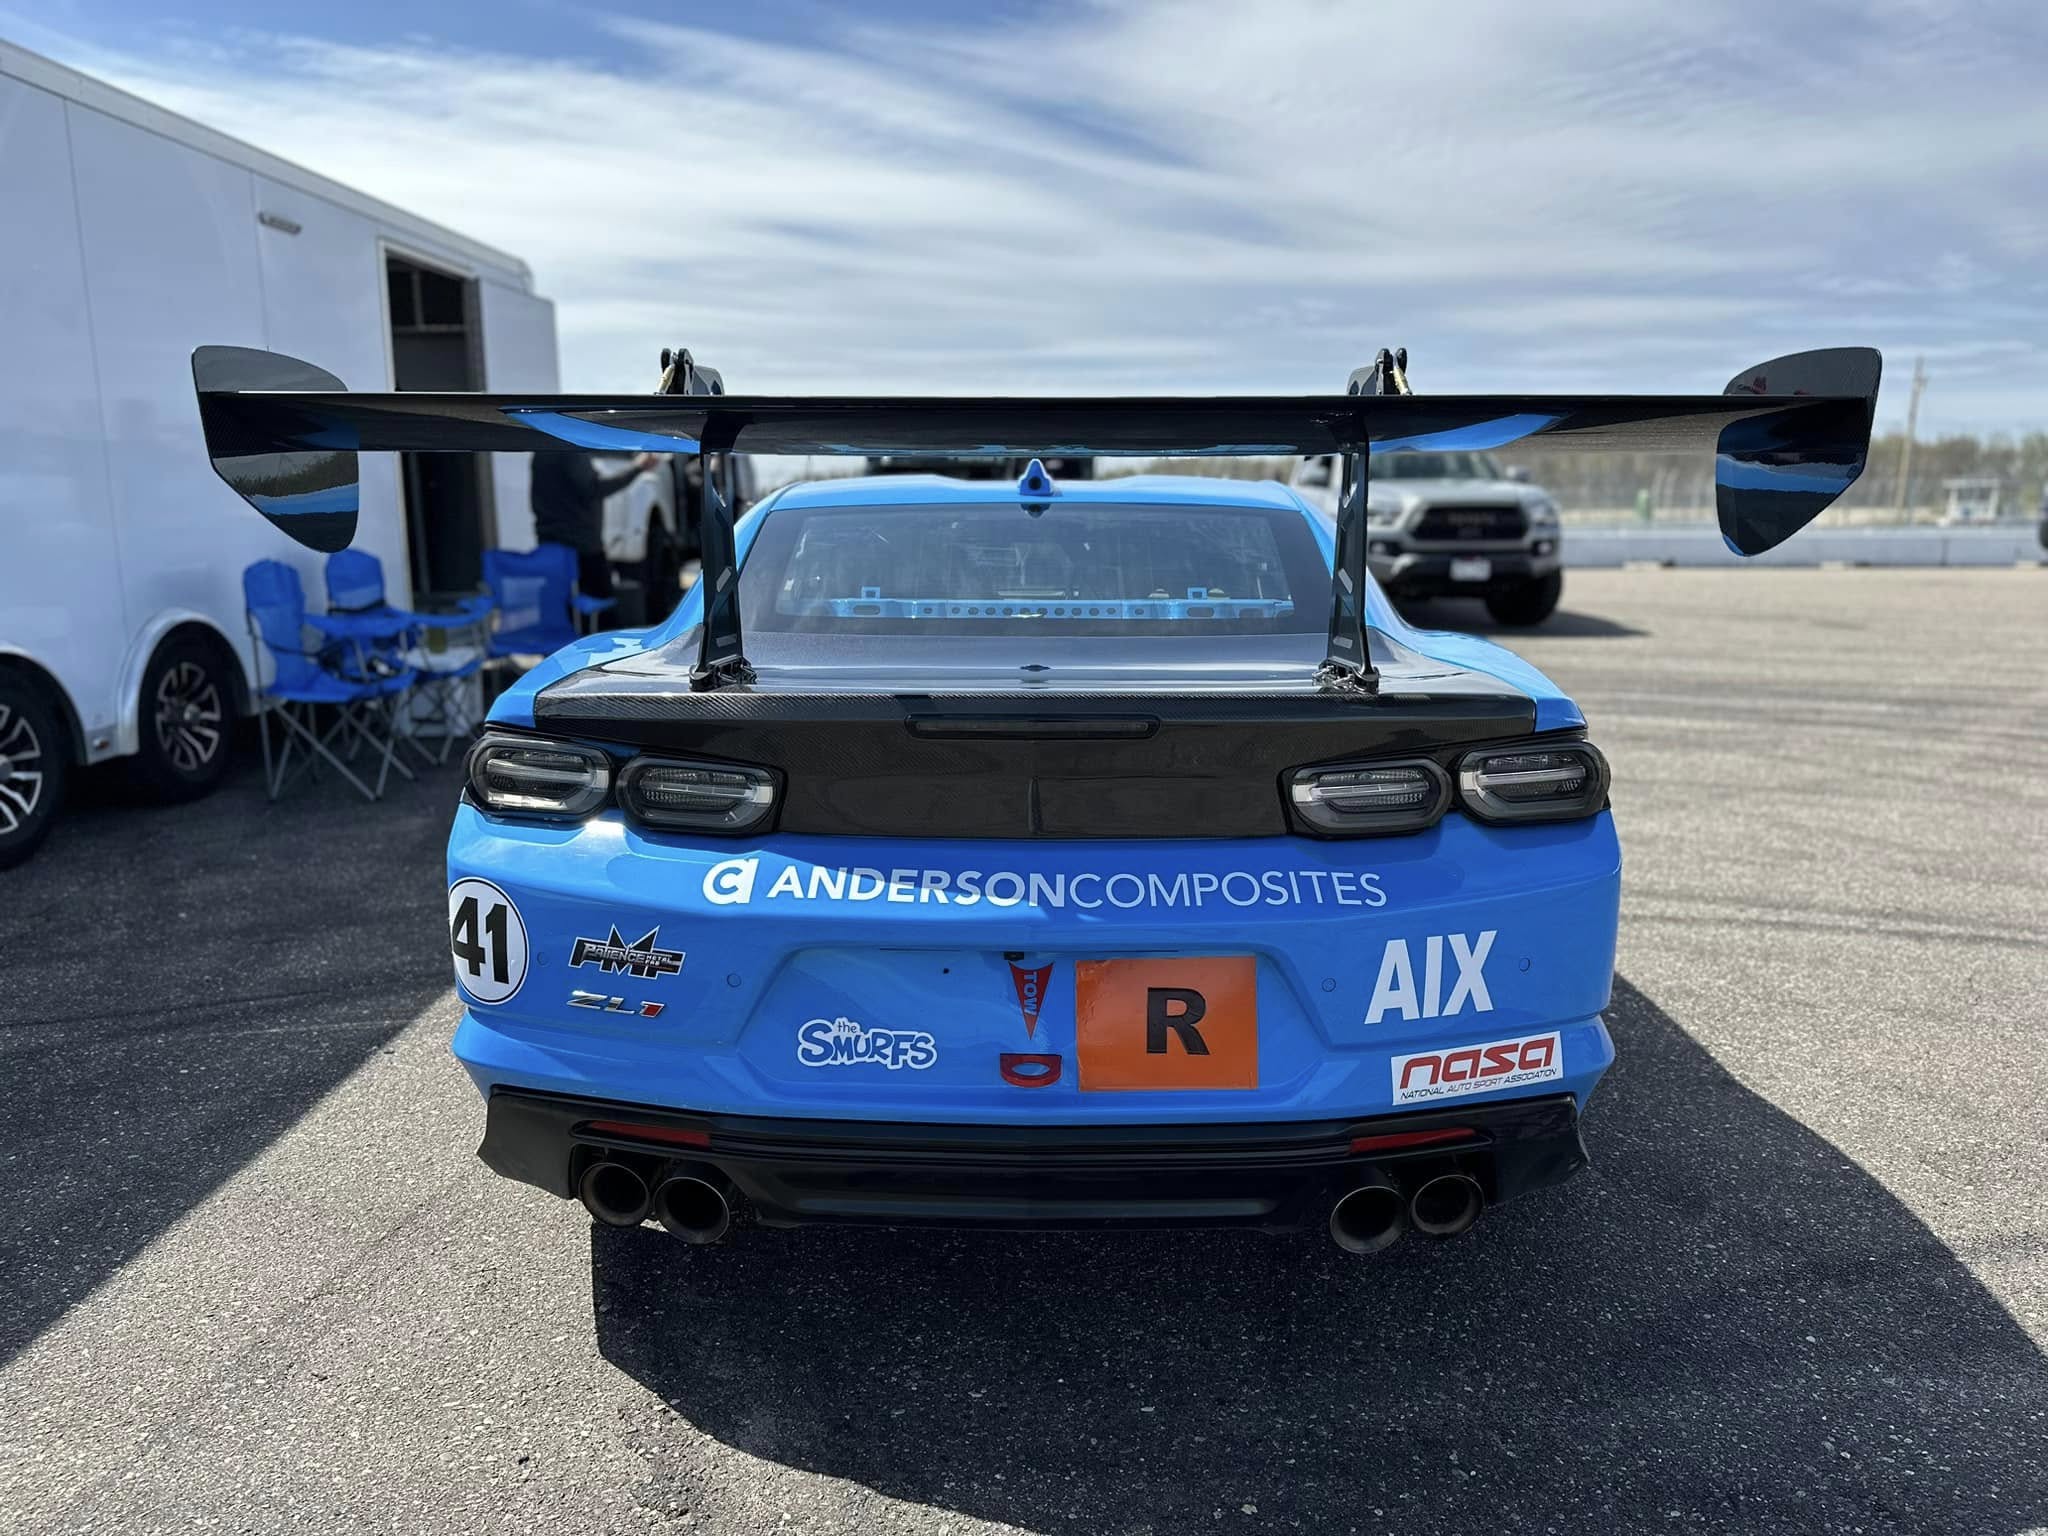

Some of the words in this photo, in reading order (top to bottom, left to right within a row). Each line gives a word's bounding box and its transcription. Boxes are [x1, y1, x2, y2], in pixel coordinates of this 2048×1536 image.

[452, 896, 509, 984] 41
[1023, 971, 1038, 1016] TOW
[1364, 930, 1497, 1024] AIX
[566, 990, 665, 1018] ZL1
[1147, 986, 1210, 1056] R
[838, 1021, 858, 1034] the
[1400, 1087, 1445, 1100] NATIONAL
[1446, 1082, 1472, 1094] AUTO
[1473, 1077, 1503, 1090] SPORT
[1503, 1068, 1558, 1085] ASSOCIATION
